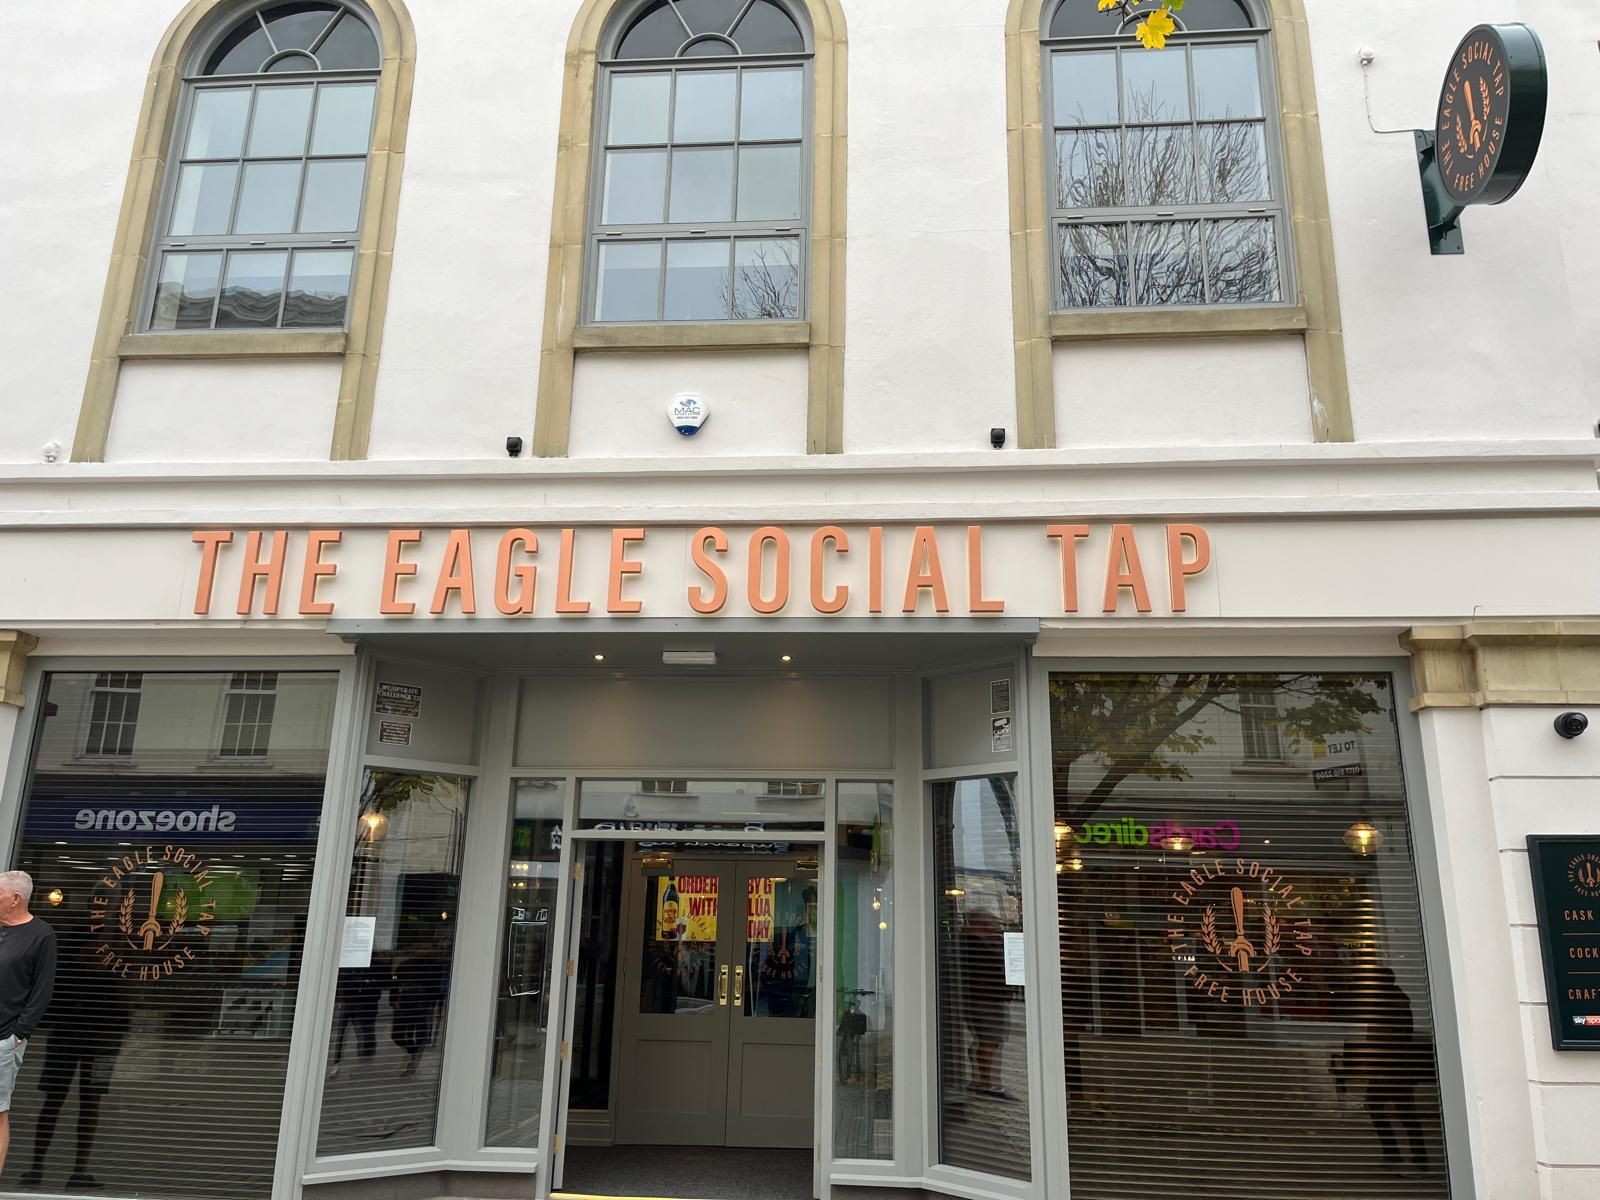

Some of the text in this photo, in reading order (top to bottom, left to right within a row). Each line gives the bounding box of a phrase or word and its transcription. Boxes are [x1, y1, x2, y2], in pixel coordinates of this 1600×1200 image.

[1441, 41, 1505, 175] THE EAGLE SOCIAL TAP
[1453, 116, 1503, 192] FREE HOUSE
[674, 406, 701, 414] MAC
[191, 523, 1212, 616] THE EAGLE SOCIAL TAP
[90, 844, 216, 936] THE EAGLE SOCIAL TAP
[678, 875, 718, 894] ORDER
[1167, 858, 1313, 956] THE EAGLE SOCIAL TAP
[1564, 909, 1594, 921] CASK
[95, 943, 196, 981] FREE HOUSE
[1569, 947, 1599, 959] COCK
[1183, 964, 1303, 1007] FREE HOUSE
[1573, 1016, 1586, 1025] sky
